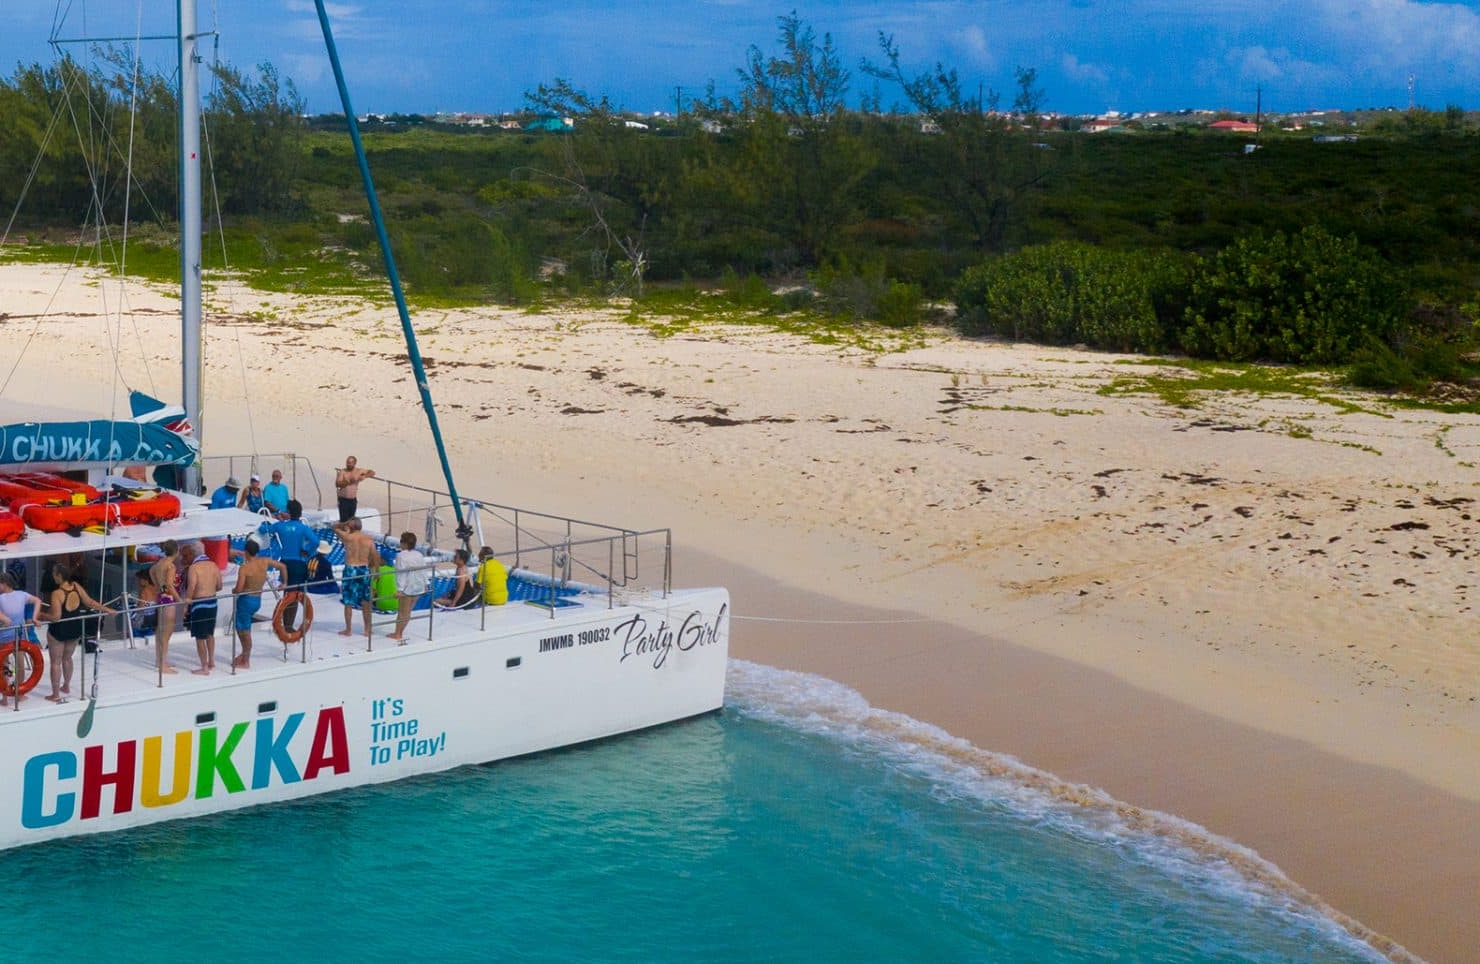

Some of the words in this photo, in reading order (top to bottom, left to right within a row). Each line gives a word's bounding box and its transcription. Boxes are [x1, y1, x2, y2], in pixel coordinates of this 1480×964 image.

[538, 633, 574, 653] JMWMB
[577, 627, 611, 646] 190032
[613, 613, 673, 669] Party
[677, 602, 727, 652] Girl
[372, 697, 404, 720] It's
[370, 719, 418, 743] Time
[369, 745, 391, 766] To
[397, 731, 446, 760] Play!
[21, 705, 351, 829] CHUKKA
